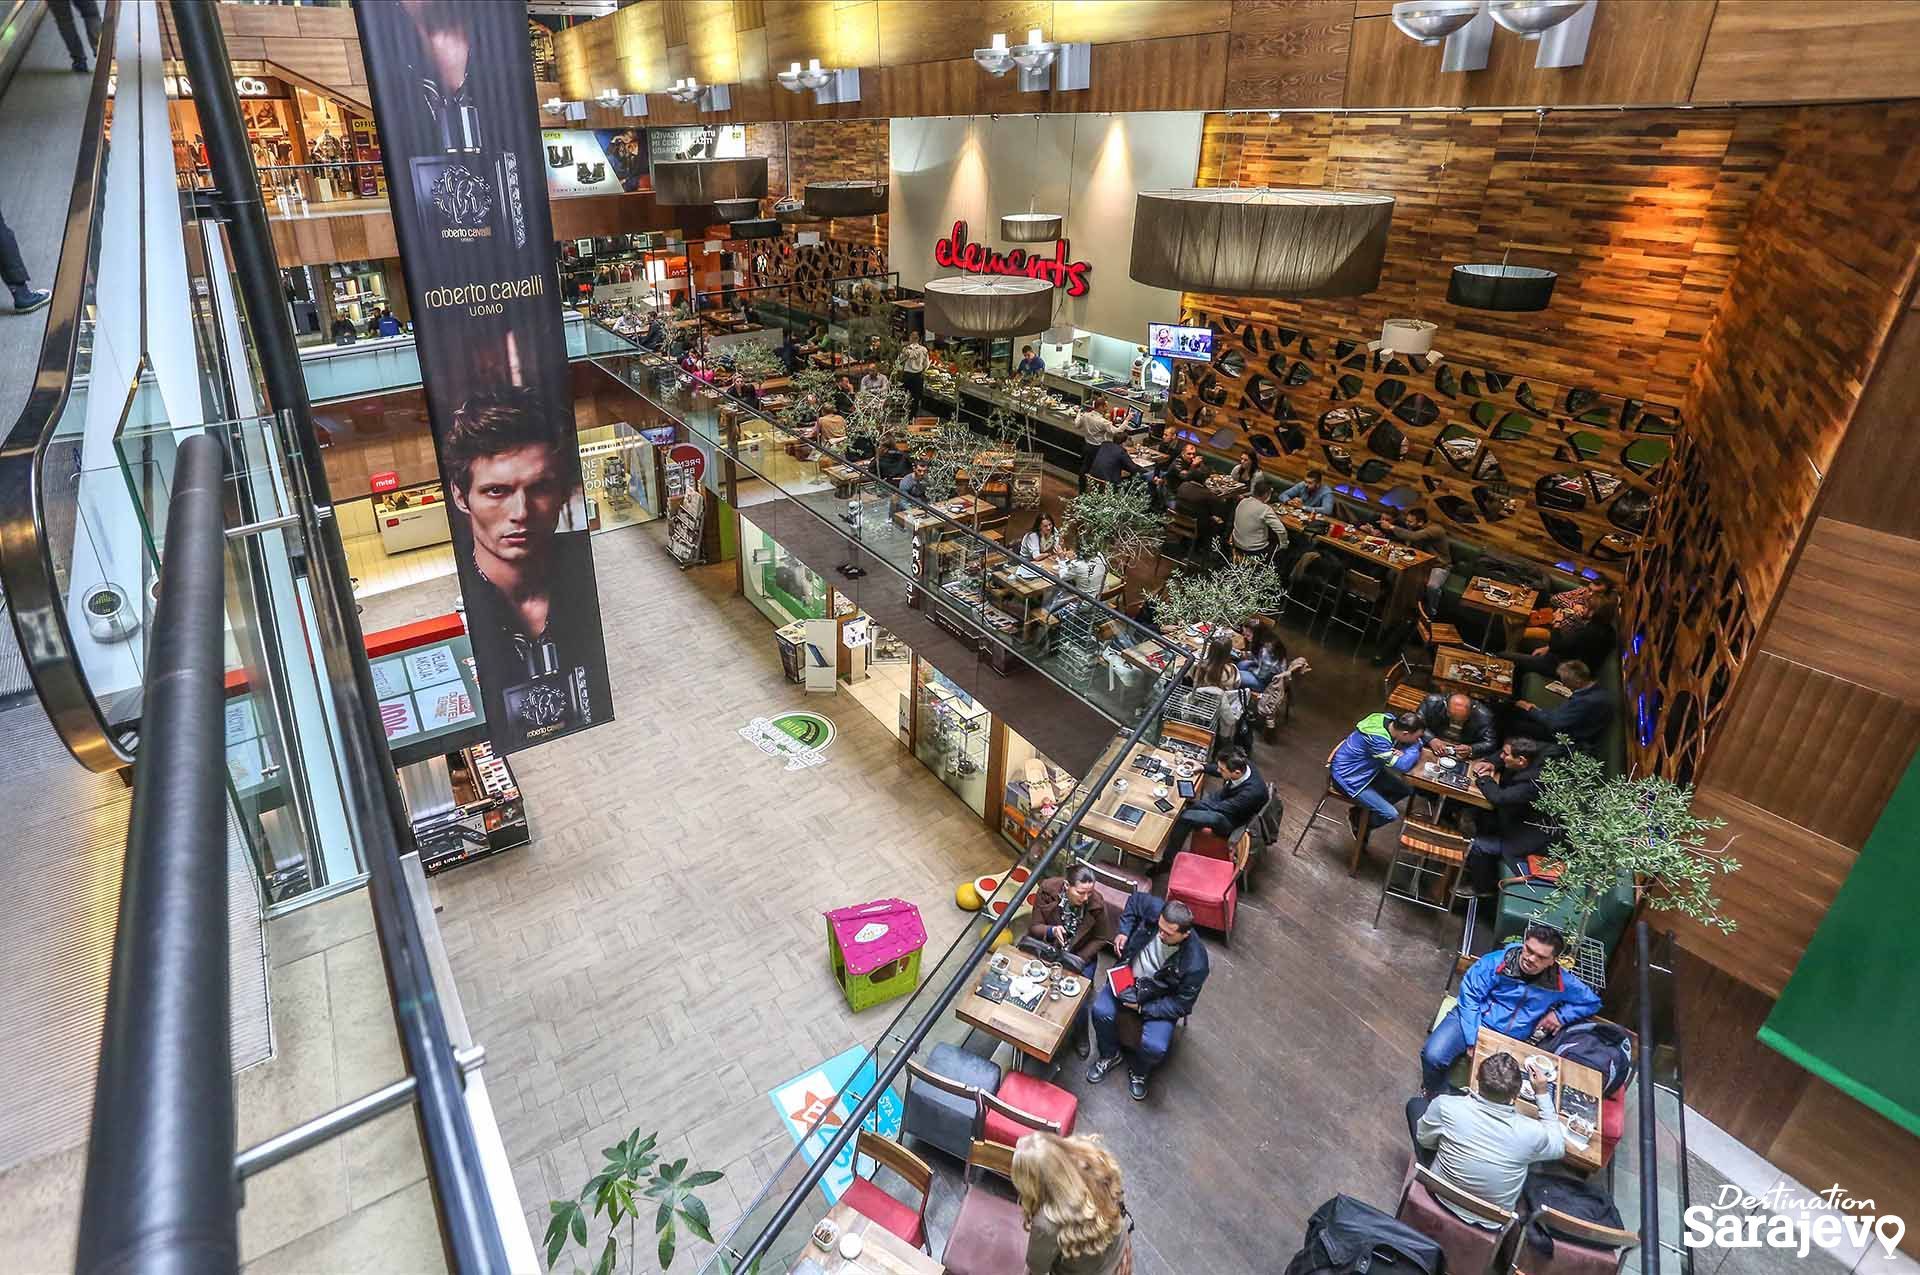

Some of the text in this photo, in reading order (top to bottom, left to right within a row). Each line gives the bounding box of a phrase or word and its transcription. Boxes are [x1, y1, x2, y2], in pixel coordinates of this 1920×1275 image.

[441, 227, 467, 238] roberto
[935, 220, 1092, 297] elements
[424, 274, 544, 309] roberto cavalli
[469, 304, 504, 317] UOMO
